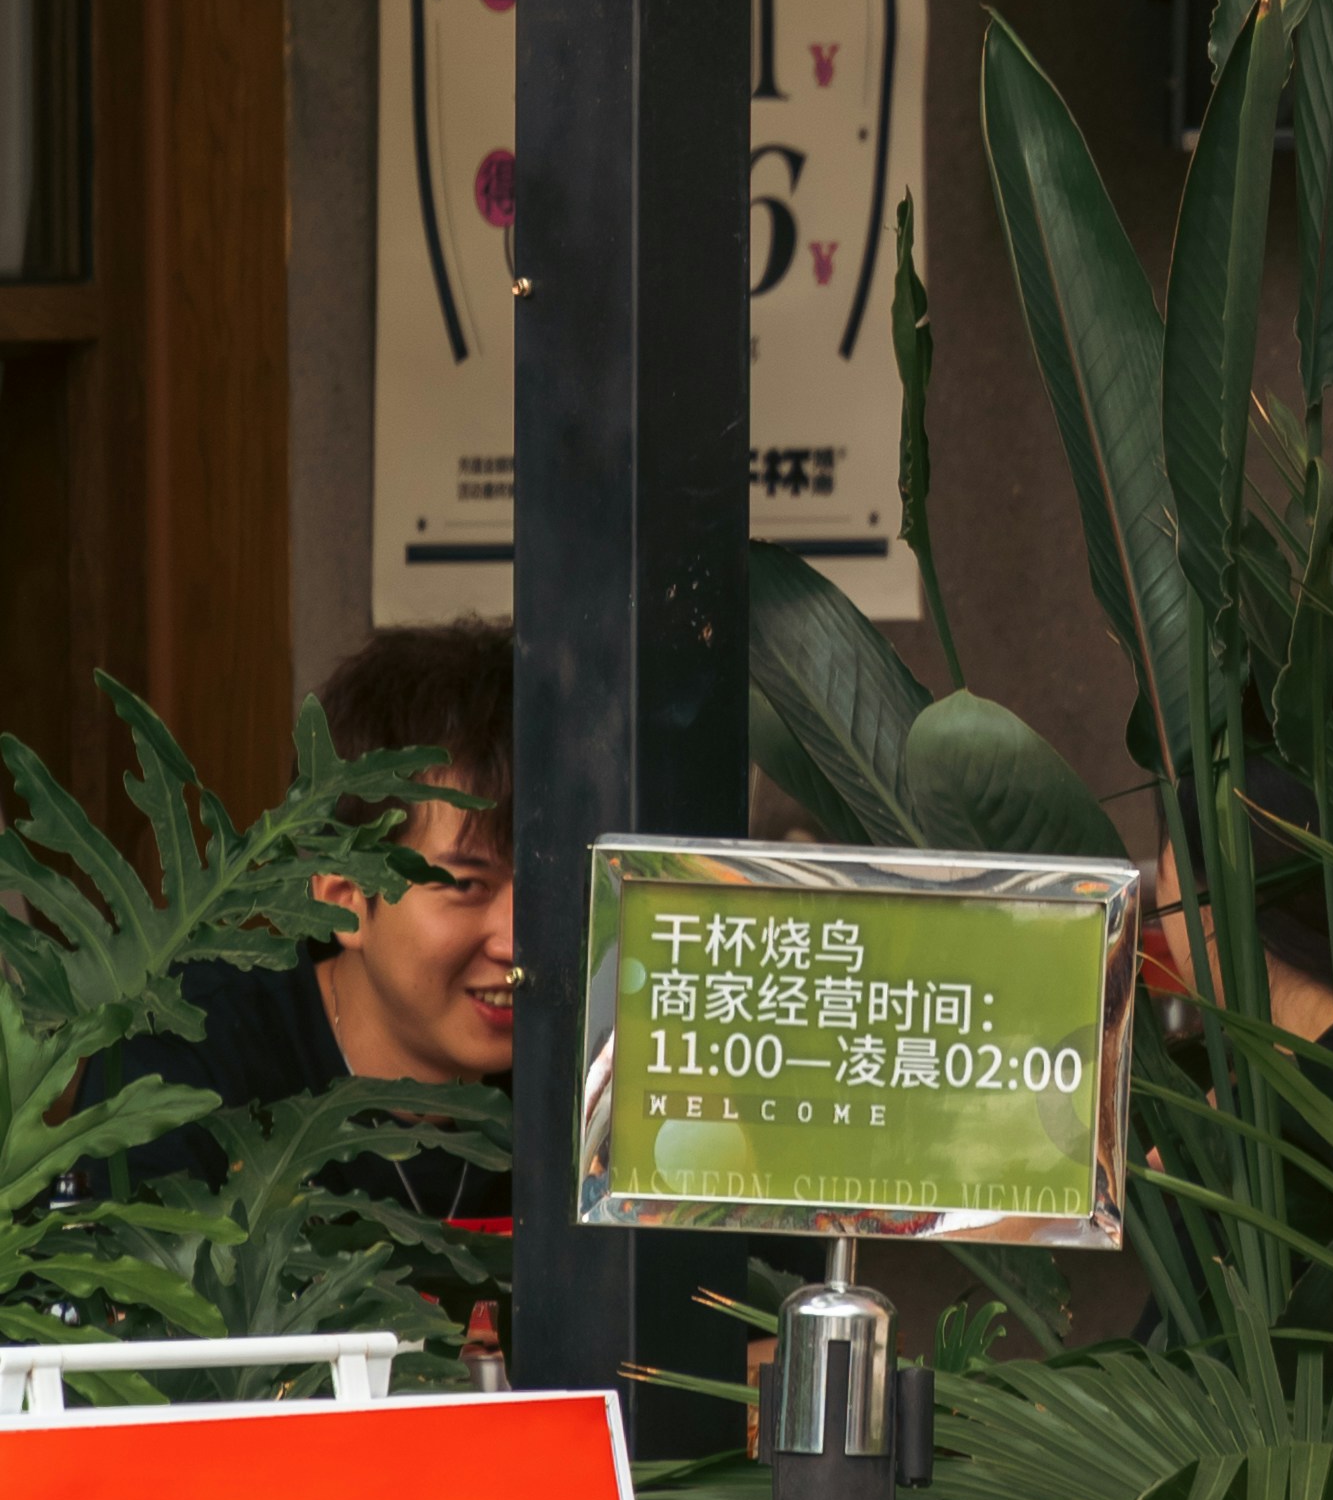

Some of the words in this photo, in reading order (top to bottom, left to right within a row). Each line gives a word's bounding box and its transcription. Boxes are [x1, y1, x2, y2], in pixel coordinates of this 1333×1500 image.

[651, 913, 864, 973] 干杯烧鸟
[650, 1094, 886, 1126] WELCOME
